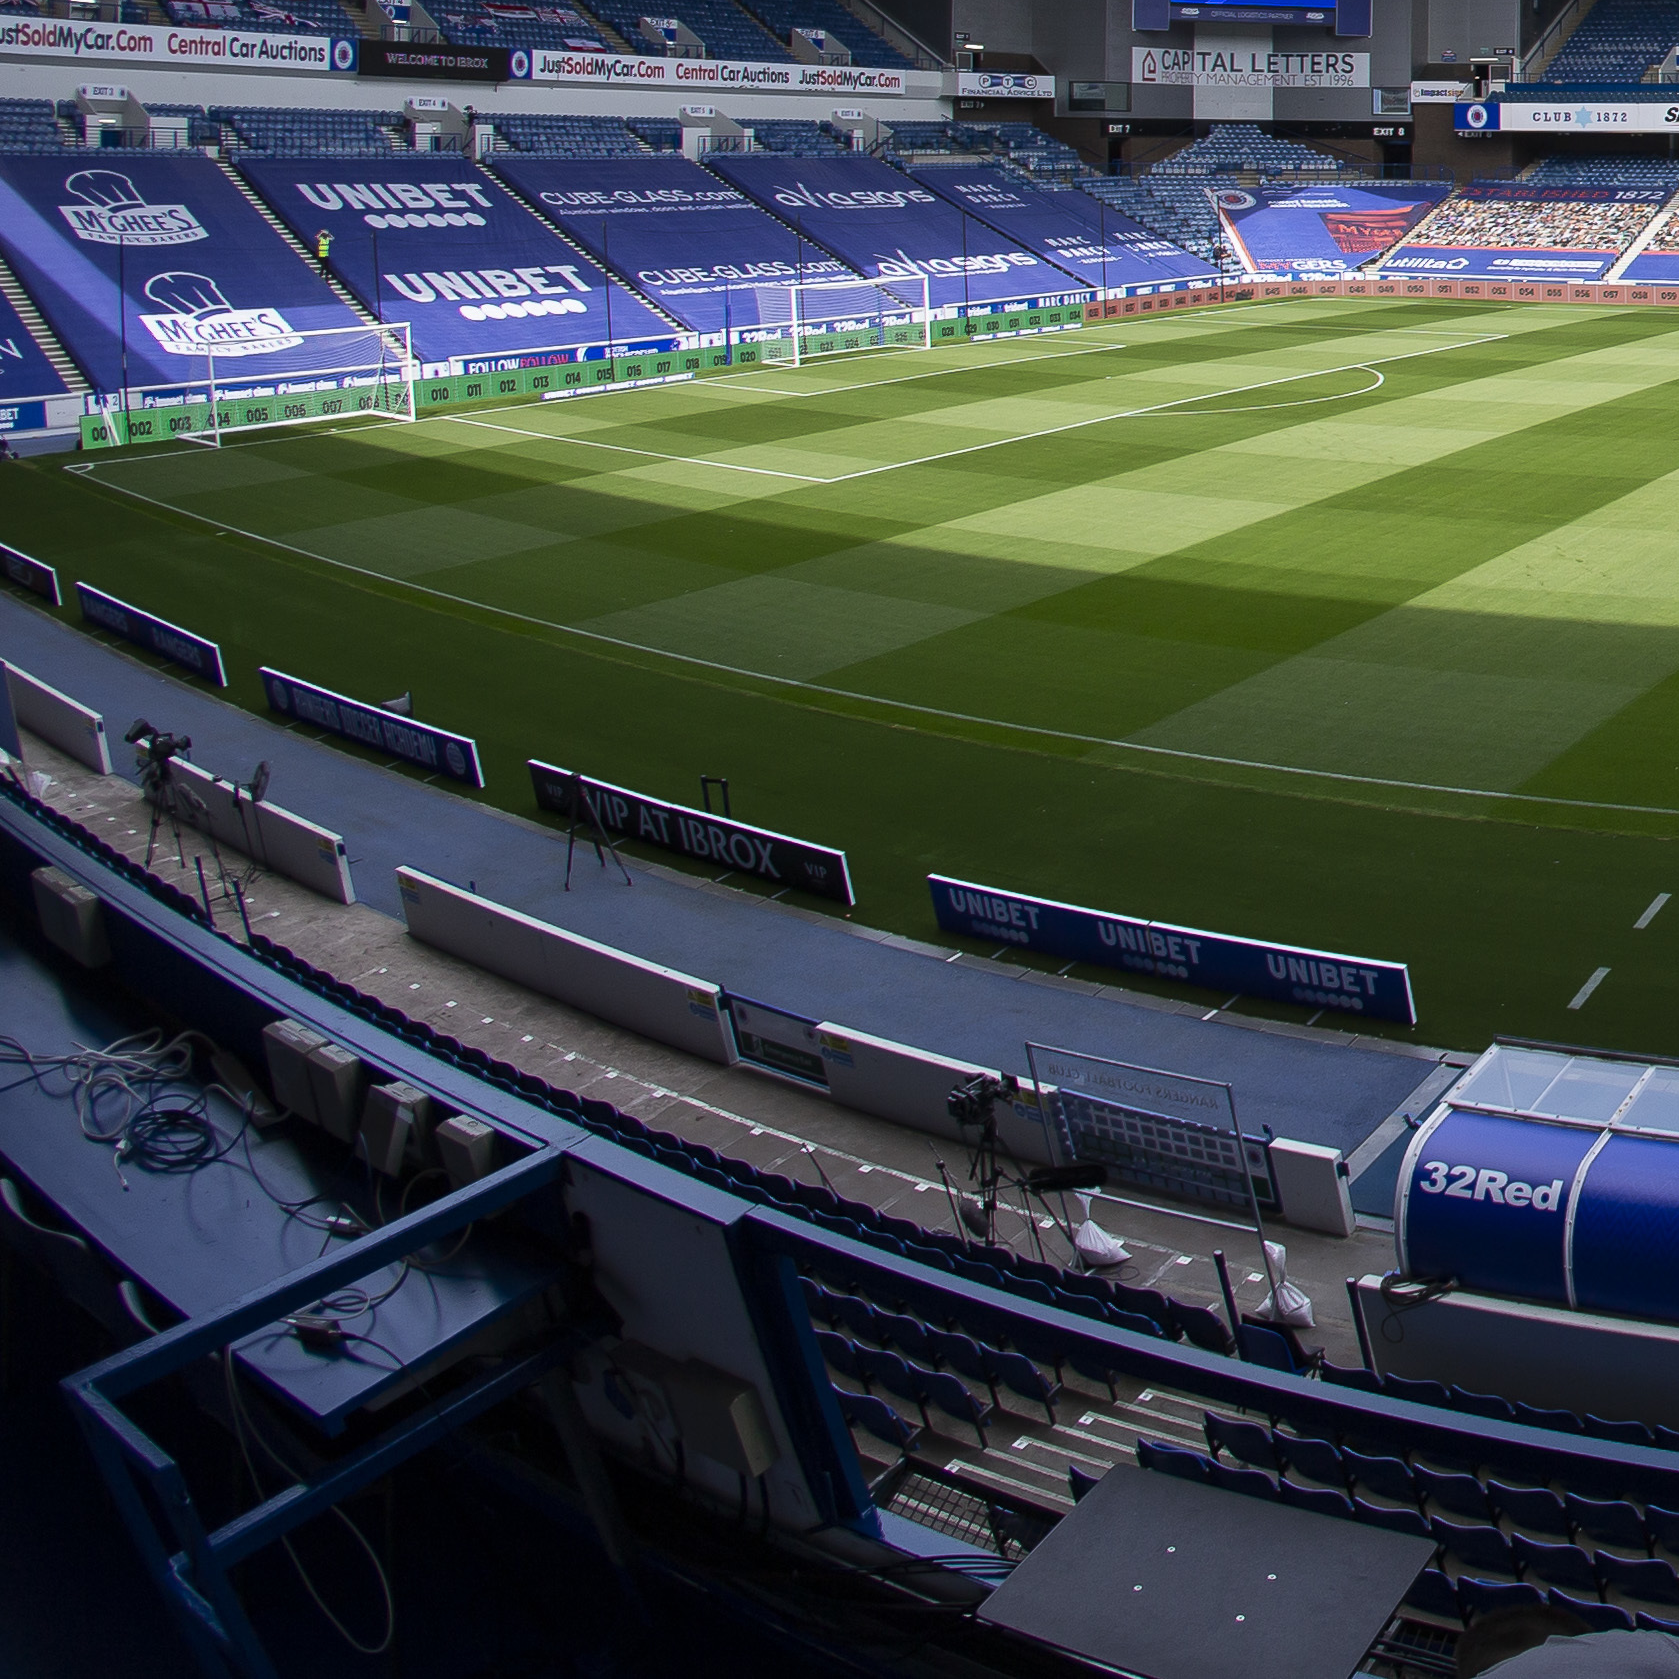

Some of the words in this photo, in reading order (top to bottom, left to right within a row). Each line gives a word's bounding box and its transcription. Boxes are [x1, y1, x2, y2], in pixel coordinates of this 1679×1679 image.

[168, 32, 226, 57] Central
[229, 36, 257, 59] Car
[259, 38, 326, 62] Auctions
[539, 56, 665, 82] JustSoldMyCar.Com
[675, 62, 718, 82] Central
[721, 65, 740, 82] Car
[741, 66, 790, 84] Auctions
[1161, 50, 1243, 73] CAPITAL
[1252, 52, 1355, 74] LETTERS
[798, 71, 901, 90] JustSoldMyCar.Com
[1206, 73, 1297, 86] MANAGEMENT
[1304, 74, 1325, 86] EST
[1329, 74, 1354, 86] 1996
[1532, 111, 1572, 123] CLUB
[1596, 111, 1628, 123] 1872
[295, 183, 493, 211] UNIBET
[539, 189, 745, 206] CUBE-GLASS.com
[1614, 190, 1666, 201] 1872
[383, 265, 593, 303] UNIBET
[430, 388, 450, 402] 010
[637, 803, 670, 845] AT
[679, 816, 781, 879] IBROX
[947, 887, 1040, 930] UNIBET
[1099, 922, 1201, 965] UNIBET
[1266, 953, 1379, 996] UNIBET
[1419, 1160, 1564, 1213] 32Red
